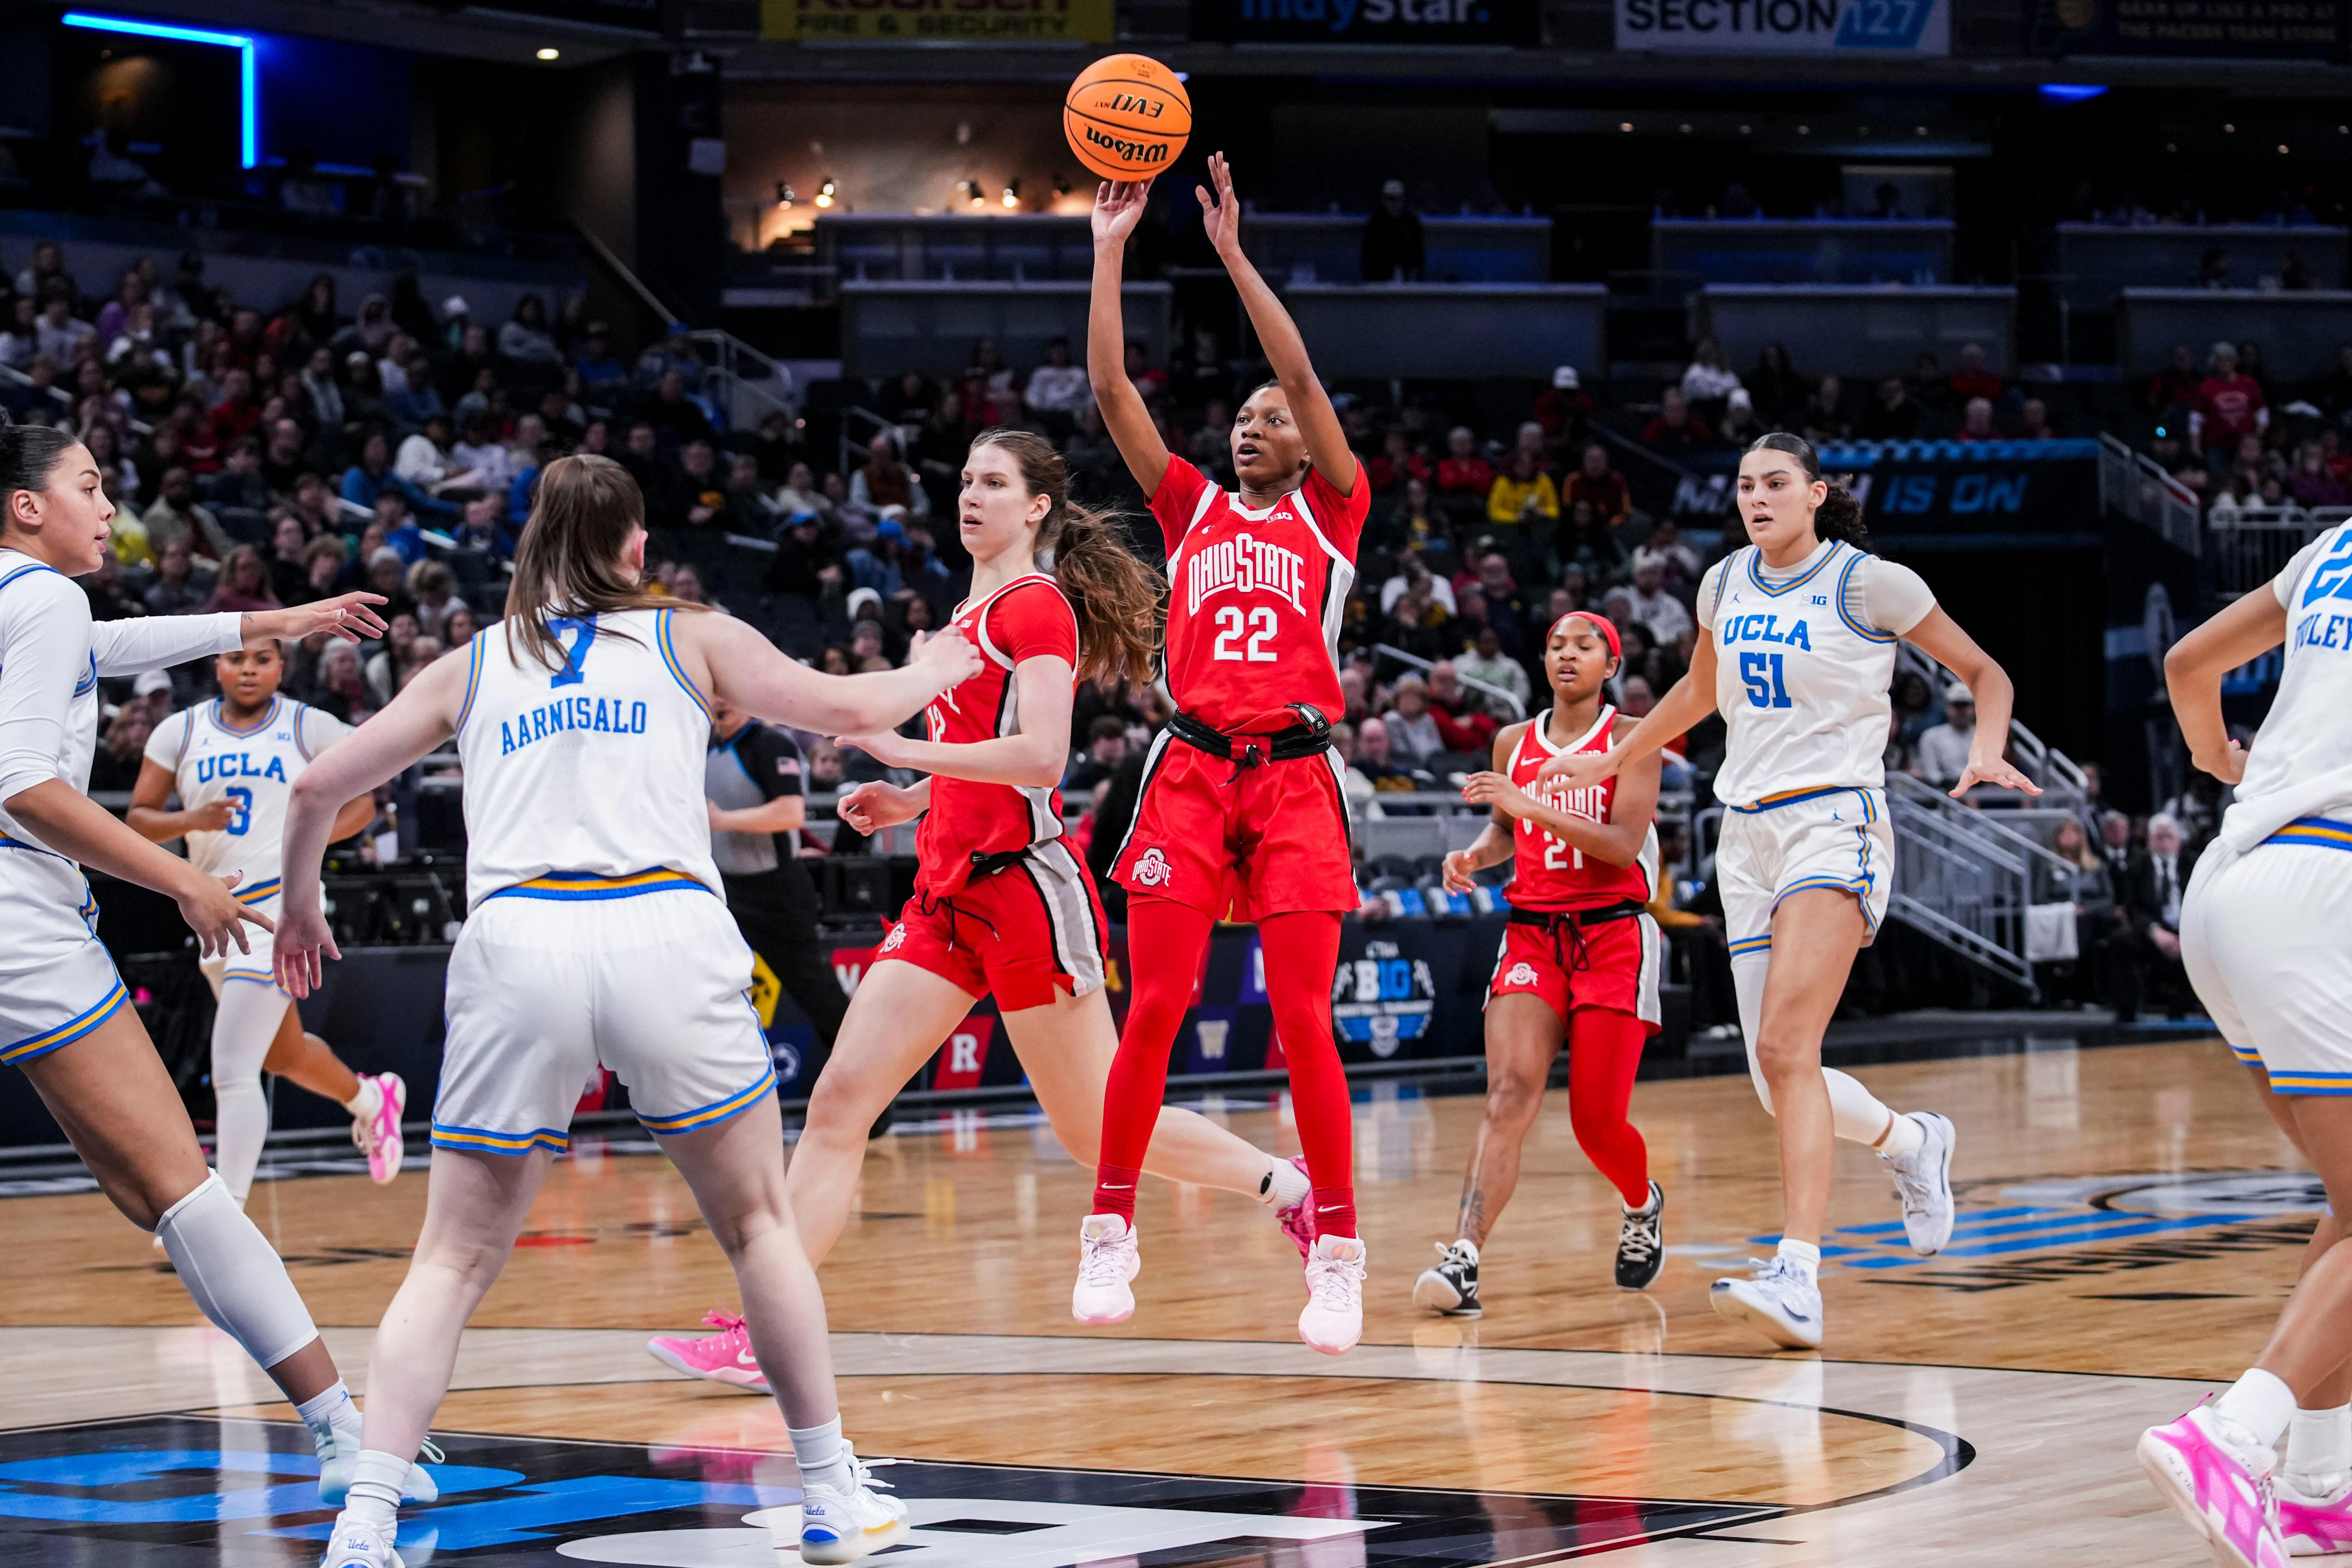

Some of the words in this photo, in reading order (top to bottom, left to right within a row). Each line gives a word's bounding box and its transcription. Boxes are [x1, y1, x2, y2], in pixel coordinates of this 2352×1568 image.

[1626, 0, 1838, 31] SECTION
[1847, 0, 1917, 35] 127
[1087, 125, 1168, 163] Wilson
[1881, 474, 1939, 514] IS
[1950, 472, 2030, 514] ON
[1214, 606, 1278, 662] 22
[1724, 615, 1811, 652] UCLA
[1740, 652, 1792, 708] 51
[502, 697, 646, 756] AARNISALO
[198, 753, 286, 783] UCLA
[225, 786, 253, 836] 3
[1544, 830, 1584, 870] 21
[951, 1033, 980, 1073] R
[805, 1505, 825, 1516] Ucla
